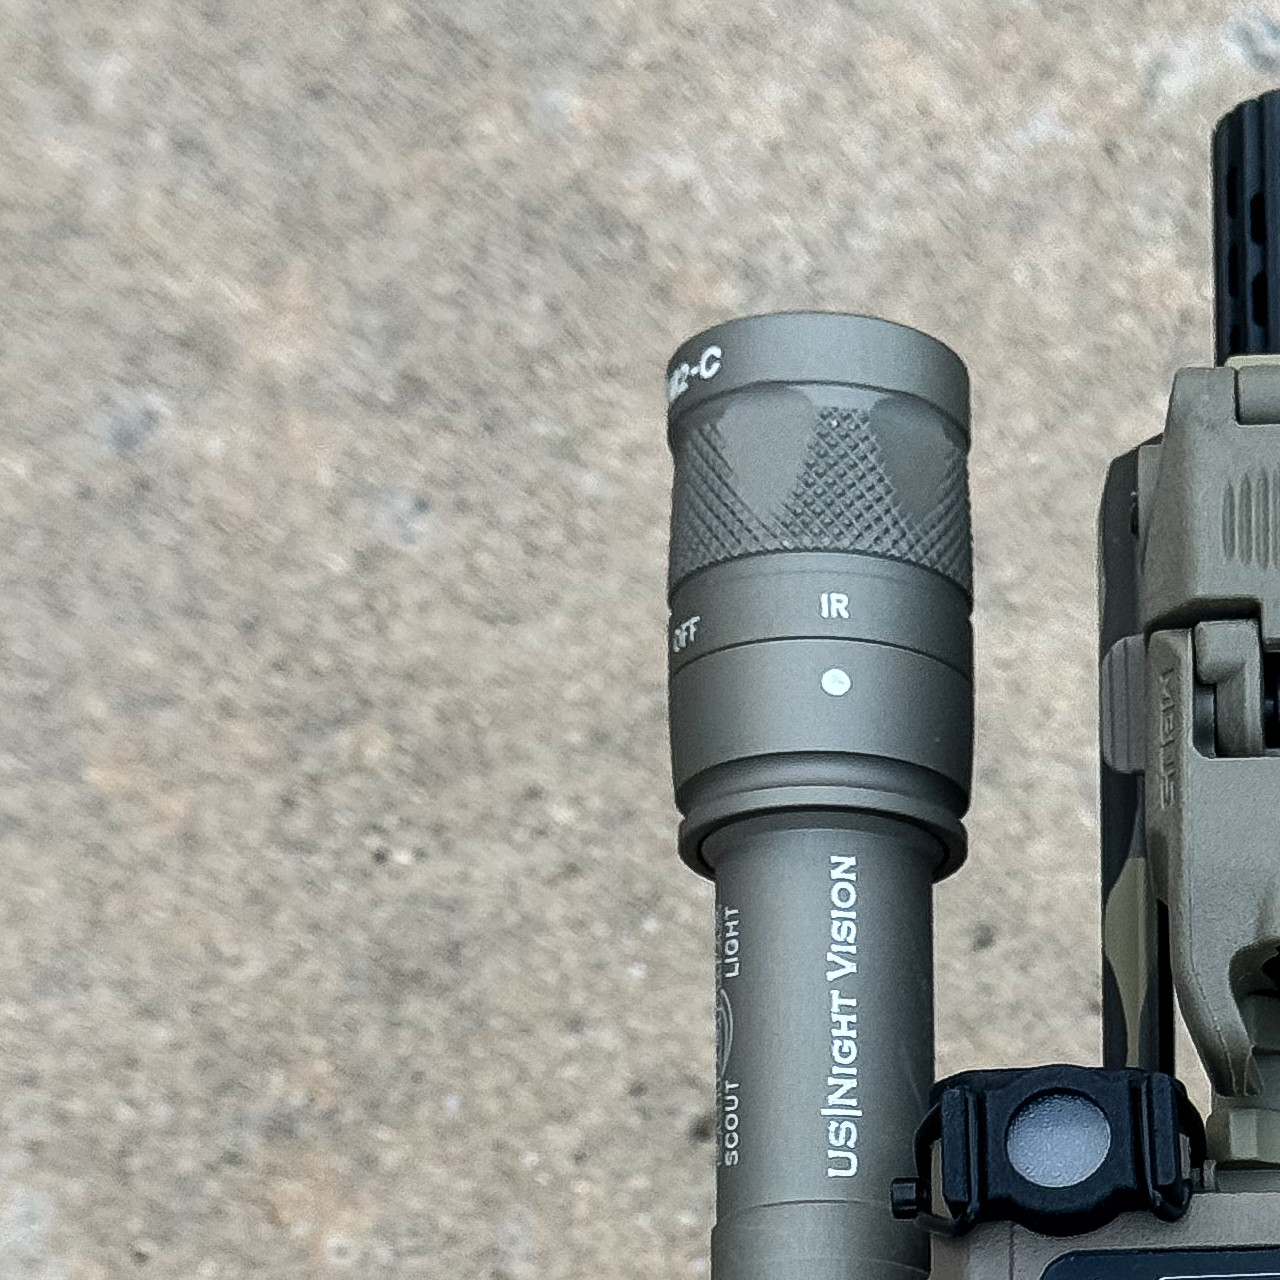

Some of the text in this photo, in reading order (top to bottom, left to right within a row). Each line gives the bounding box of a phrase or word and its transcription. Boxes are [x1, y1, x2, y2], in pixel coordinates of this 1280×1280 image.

[668, 345, 723, 402] 2-C
[820, 592, 850, 619] IR
[724, 906, 740, 1166] SCOUT LIGHT
